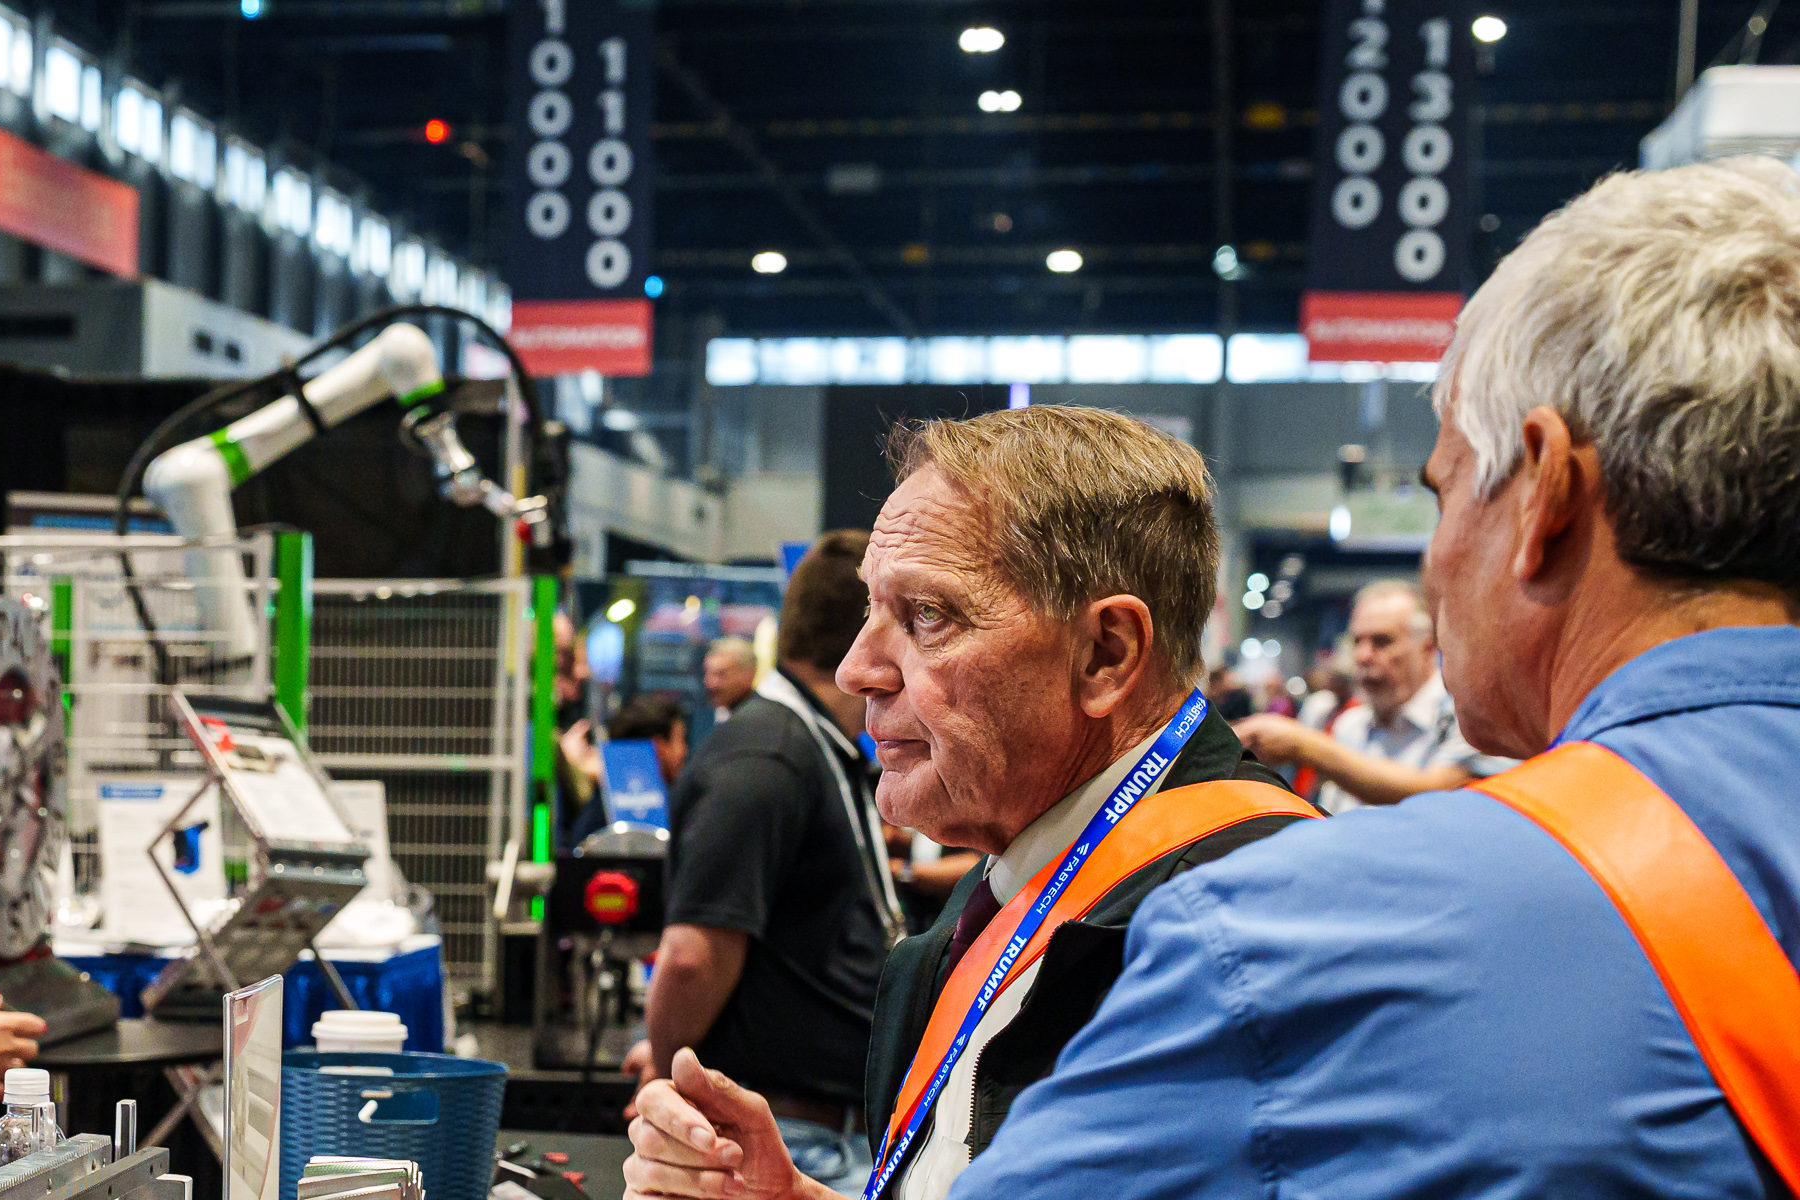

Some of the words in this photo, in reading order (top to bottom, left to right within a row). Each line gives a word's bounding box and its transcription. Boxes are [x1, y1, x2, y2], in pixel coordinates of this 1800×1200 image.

[585, 37, 634, 289] 11000
[1394, 16, 1454, 282] 13000
[1104, 751, 1169, 825] TRUMPF
[1036, 855, 1080, 915] FABTECH
[976, 934, 1028, 1012] TRUMPF
[923, 1048, 958, 1107] FABTECH
